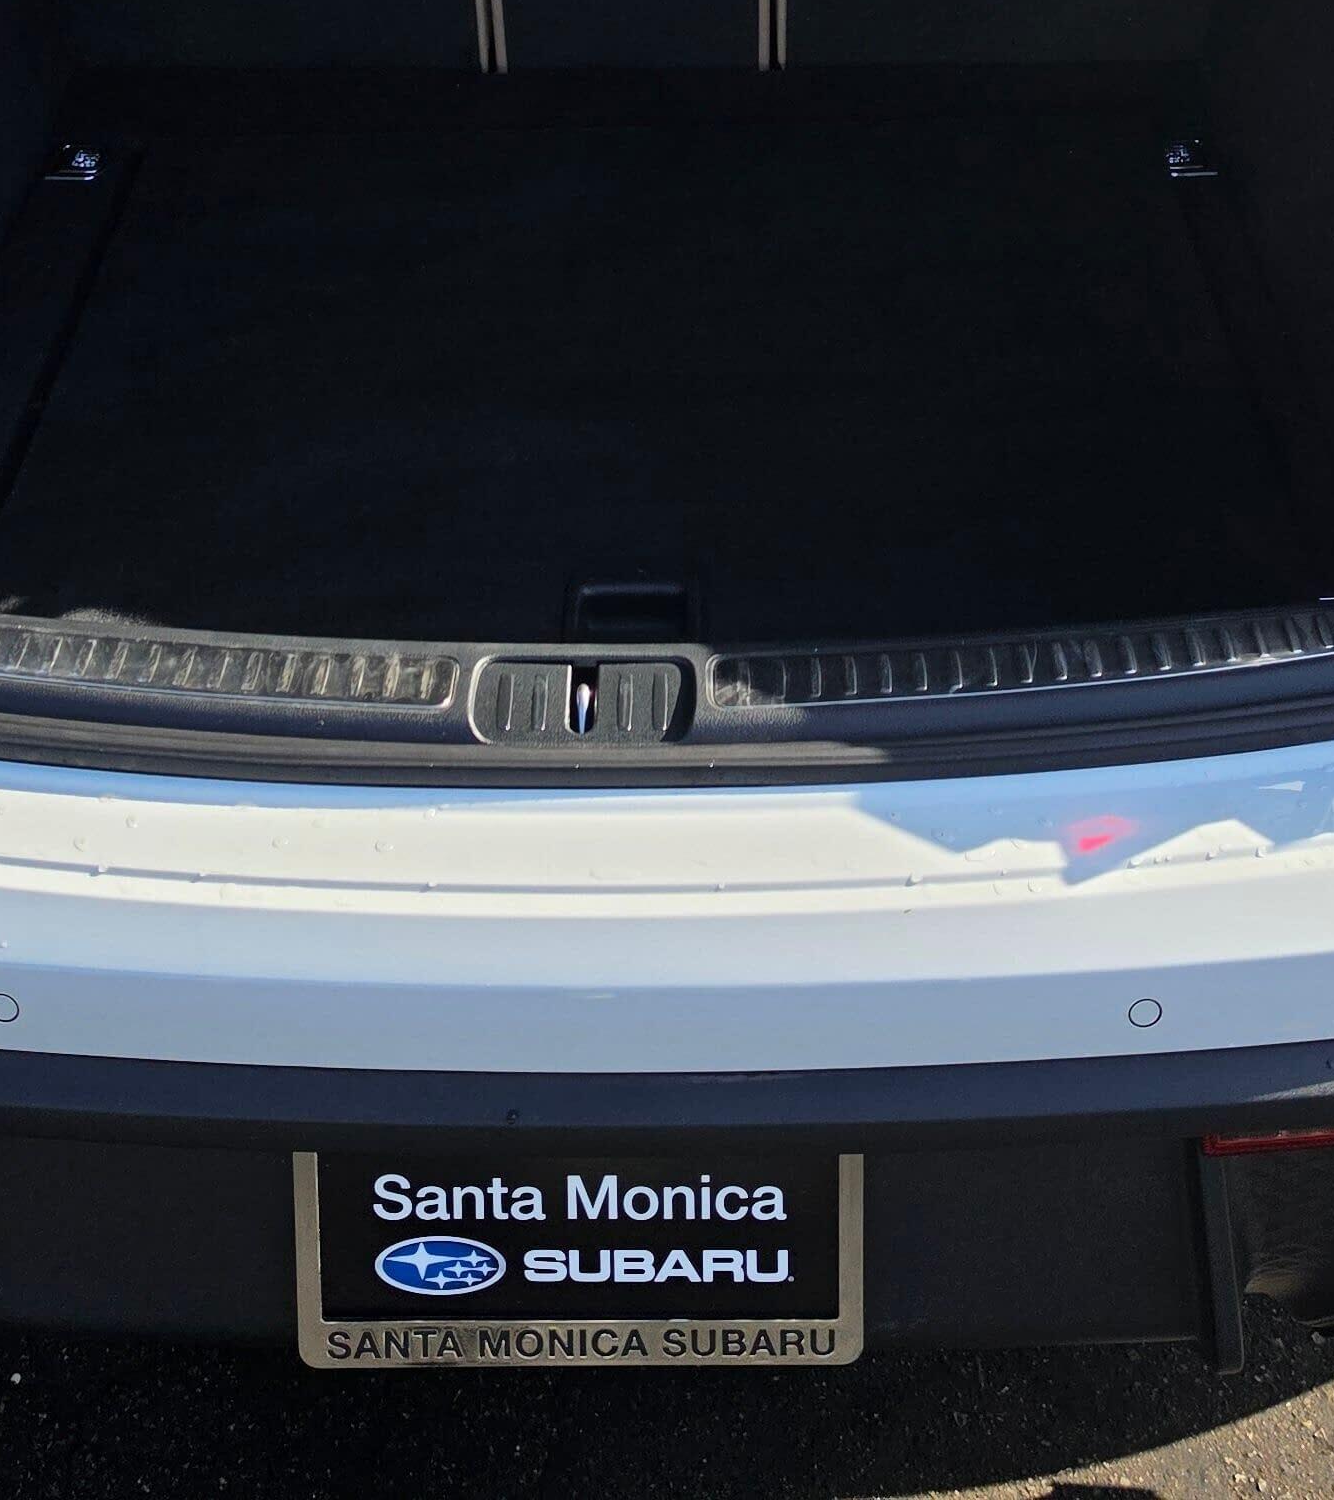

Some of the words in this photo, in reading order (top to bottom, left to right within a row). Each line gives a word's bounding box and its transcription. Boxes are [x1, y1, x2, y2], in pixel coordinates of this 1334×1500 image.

[373, 1173, 546, 1221] Santa
[567, 1174, 787, 1221] Monica
[523, 1249, 789, 1283] SUBARU
[327, 1329, 464, 1360] SANTA
[478, 1328, 649, 1360] MONICA
[662, 1328, 836, 1358] SUBARU
